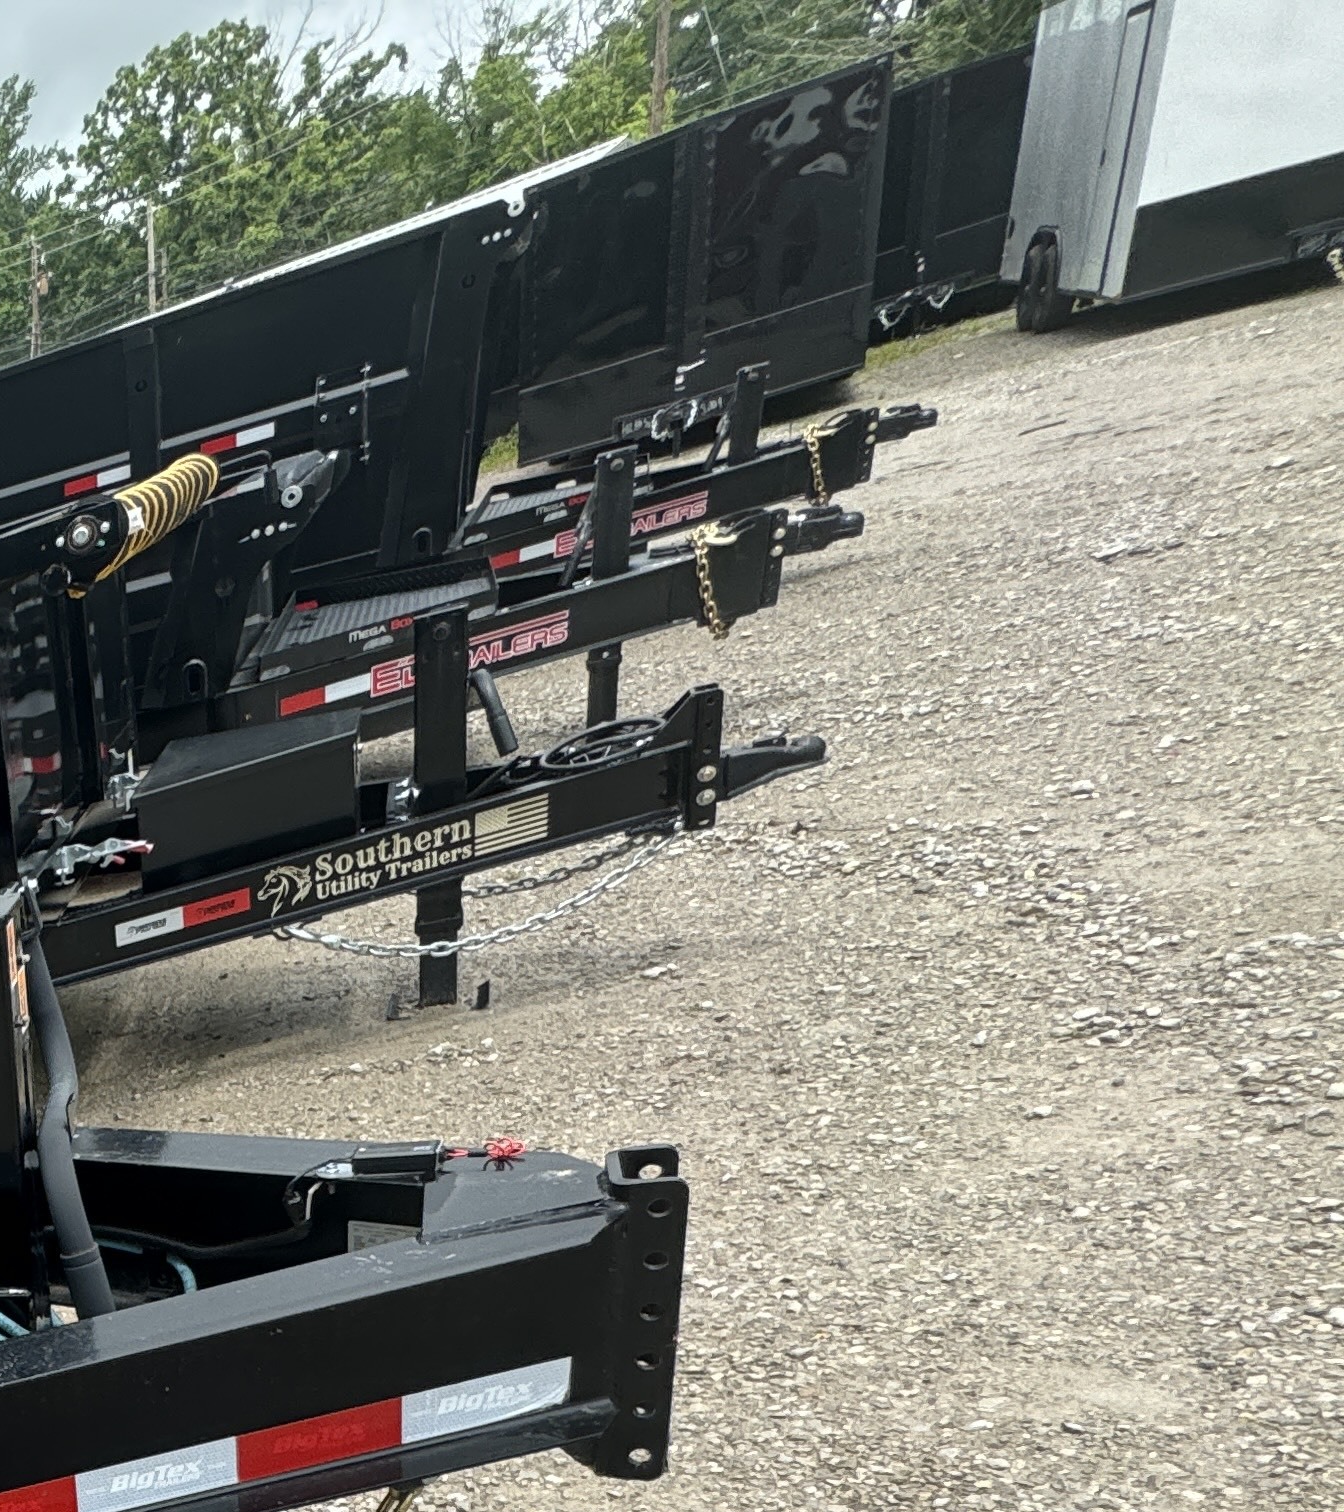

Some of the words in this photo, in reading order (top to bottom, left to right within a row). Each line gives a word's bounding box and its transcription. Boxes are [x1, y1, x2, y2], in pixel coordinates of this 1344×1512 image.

[631, 499, 708, 536] AILERS
[469, 621, 570, 670] AILERS
[314, 818, 472, 882] Southern
[316, 869, 383, 901] Utility
[385, 843, 473, 881] Trailers
[110, 1457, 204, 1494] BigTex
